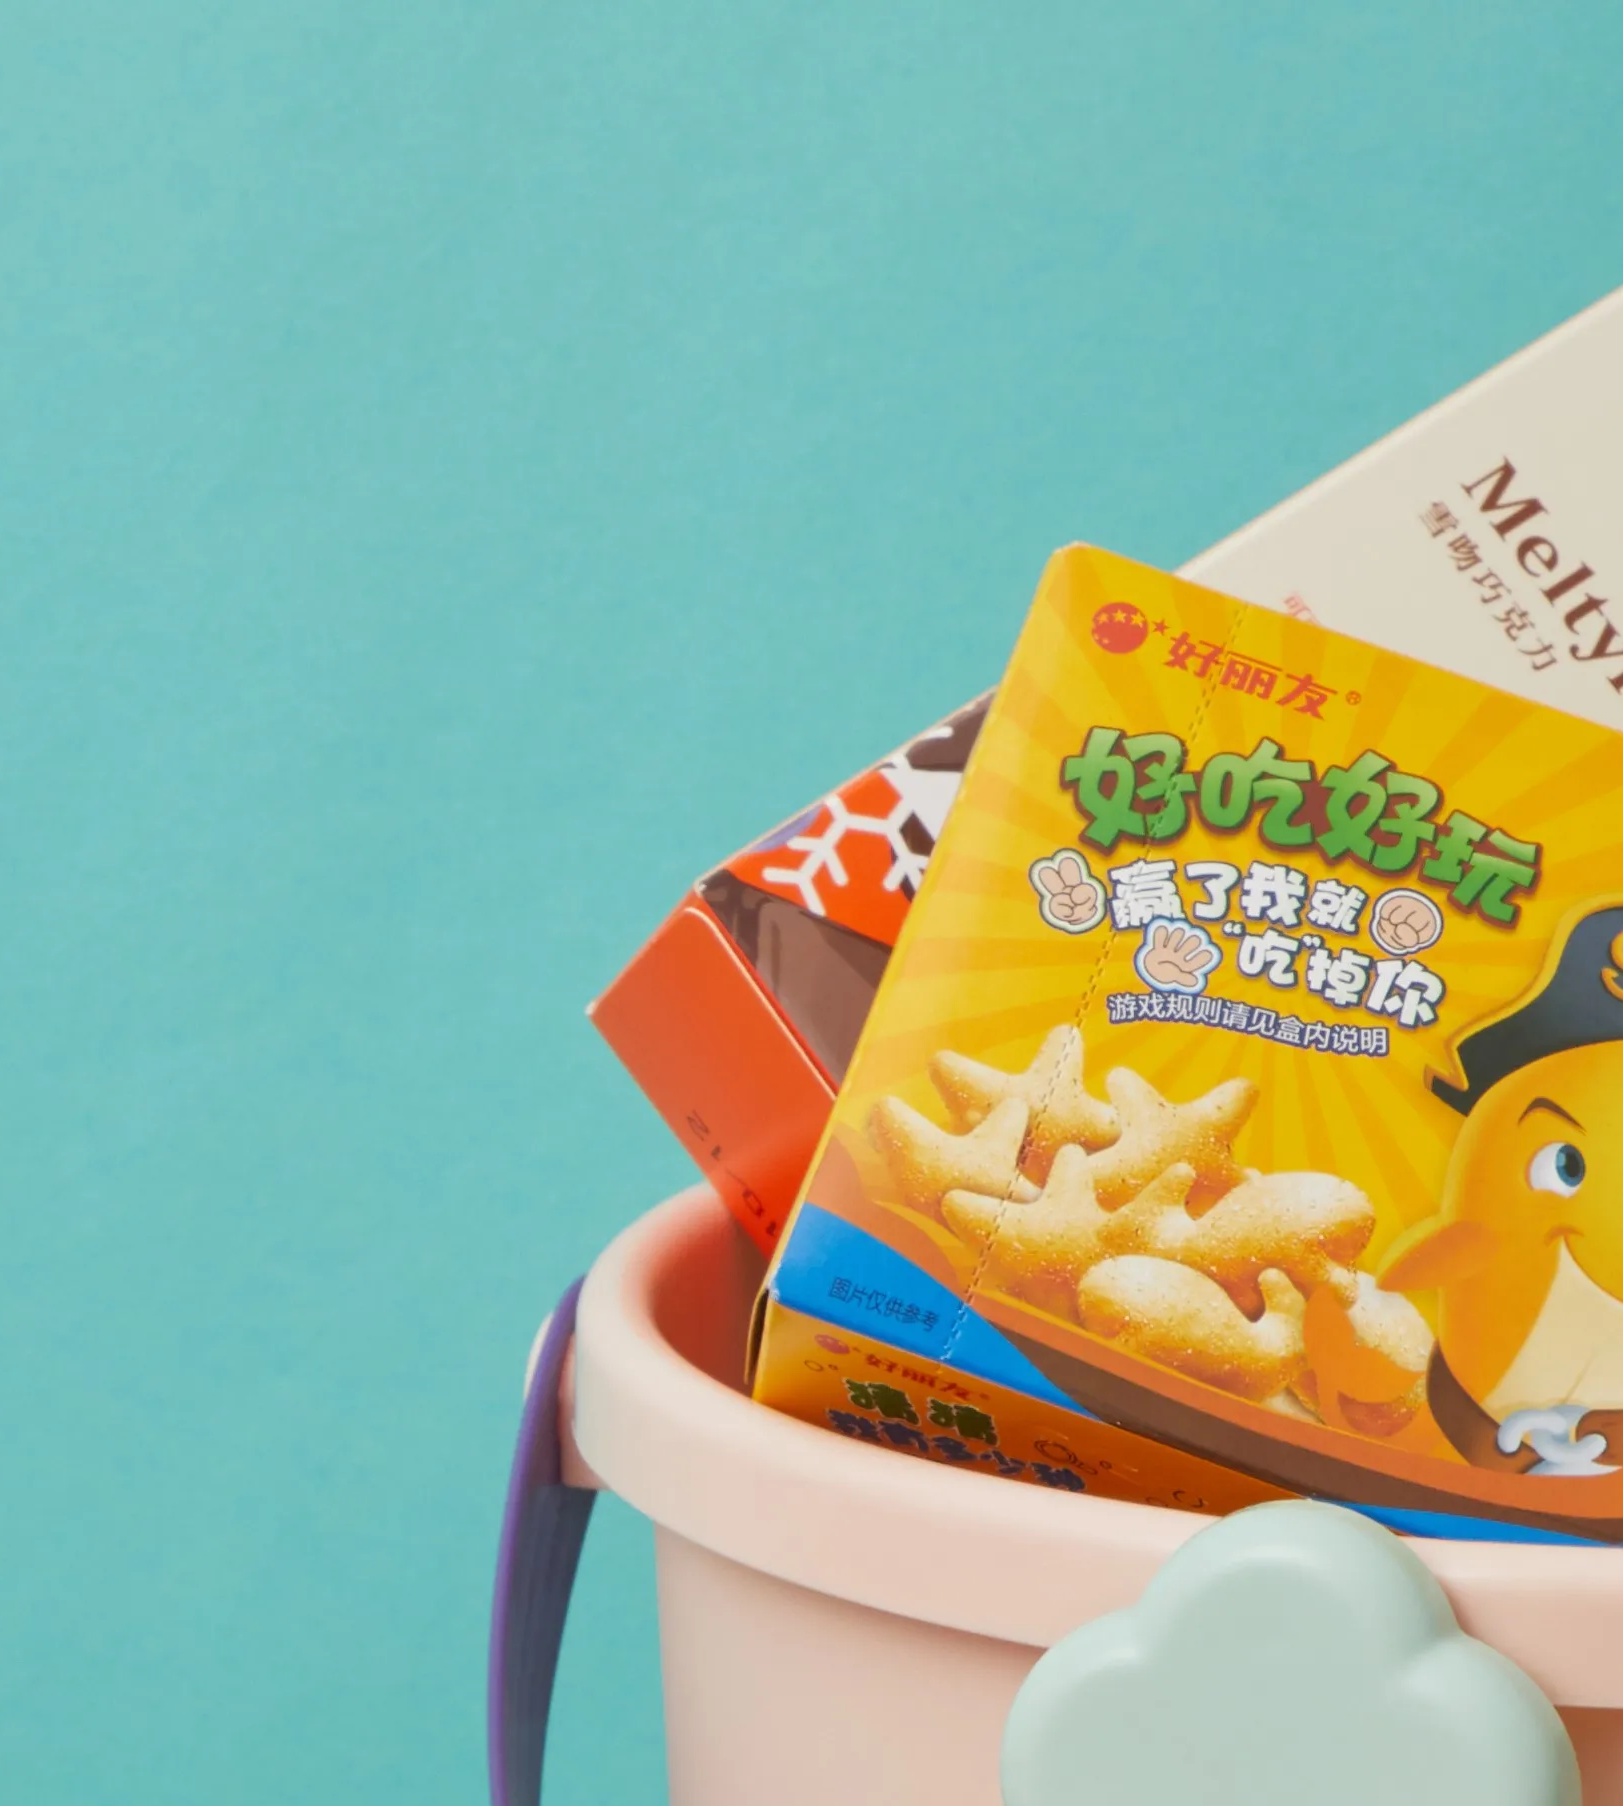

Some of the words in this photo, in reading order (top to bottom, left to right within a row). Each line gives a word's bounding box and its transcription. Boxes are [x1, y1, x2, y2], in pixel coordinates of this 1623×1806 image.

[1419, 501, 1557, 671] 雪吻巧克力
[1163, 632, 1338, 721] 好丽友
[1061, 726, 1541, 928] 好吃好玩
[1108, 858, 1368, 935] 赢了我就
[1108, 992, 1388, 1056] 游戏规则请见盒内说明
[828, 1277, 940, 1333] 图片仅供参考
